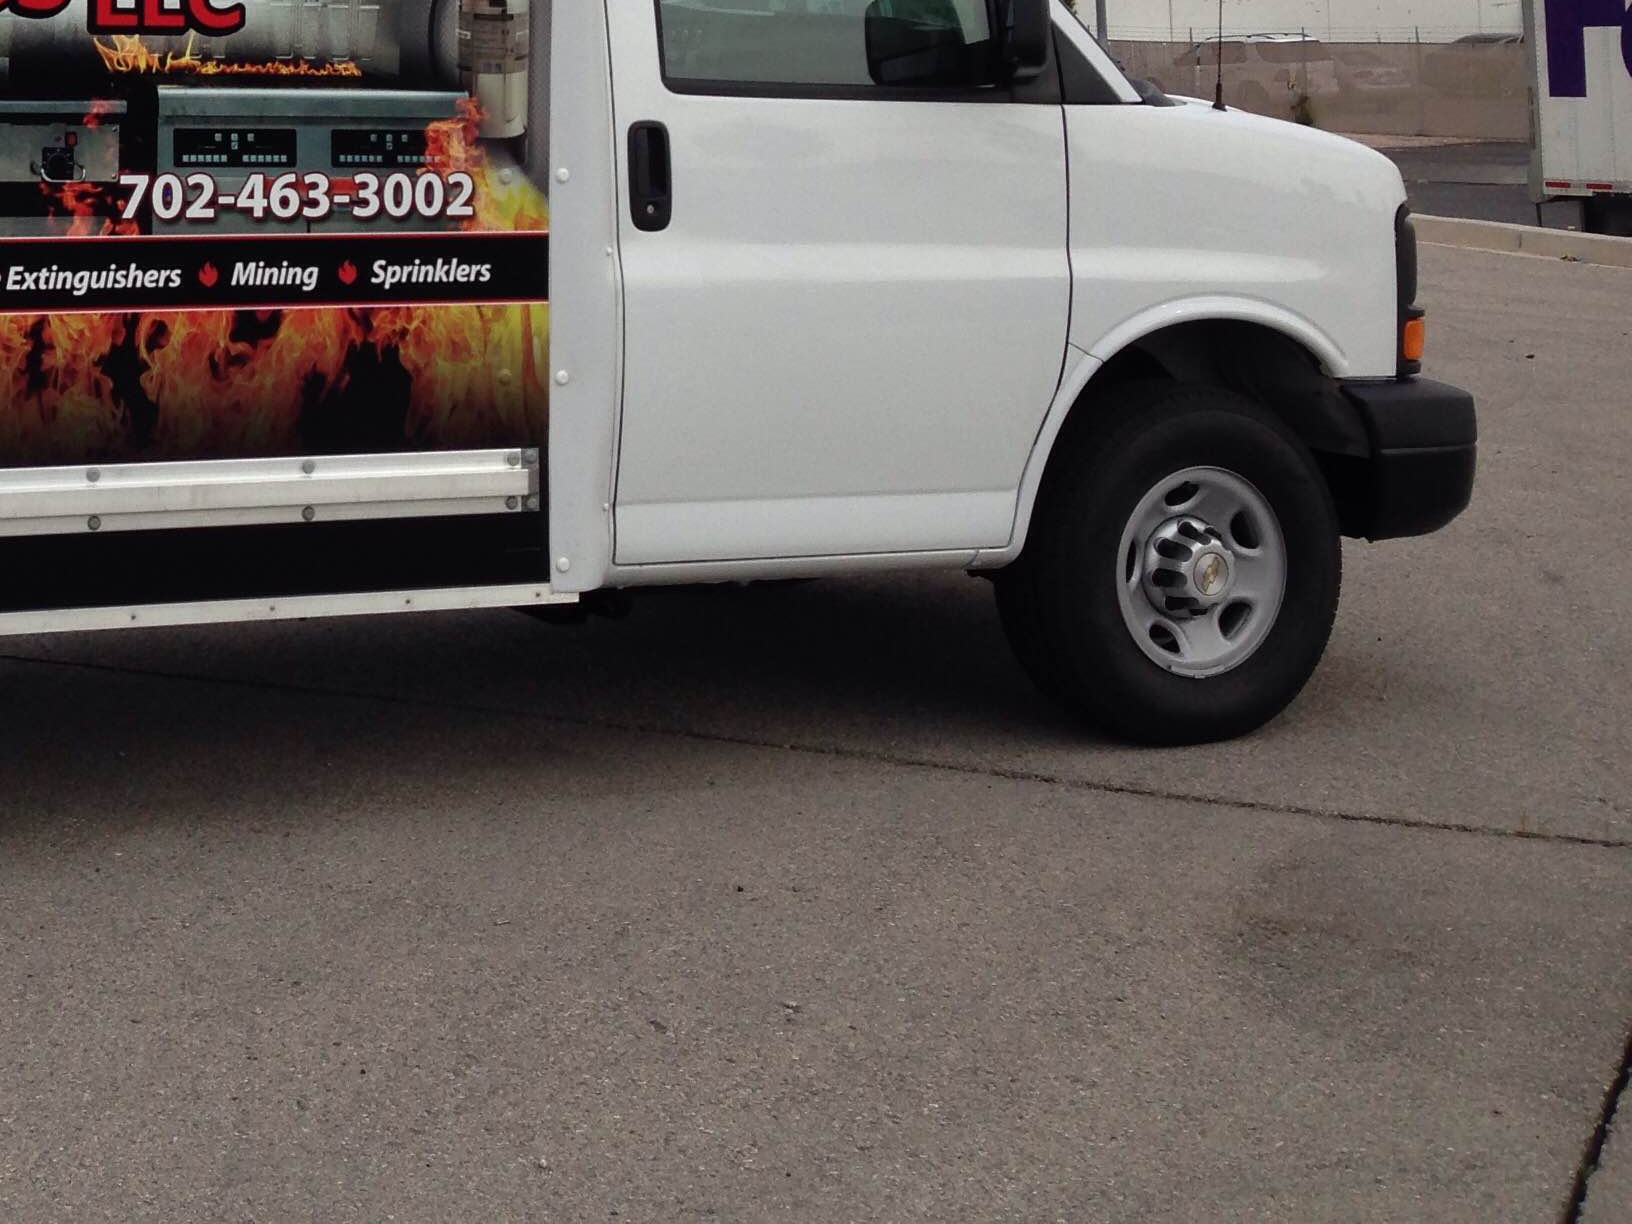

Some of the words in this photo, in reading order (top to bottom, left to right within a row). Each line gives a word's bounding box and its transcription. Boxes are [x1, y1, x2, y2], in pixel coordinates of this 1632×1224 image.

[121, 174, 472, 218] 702-463-3002
[6, 263, 181, 295] Extinguishers
[231, 261, 318, 290] Mining
[371, 258, 491, 289] Sprinklers
